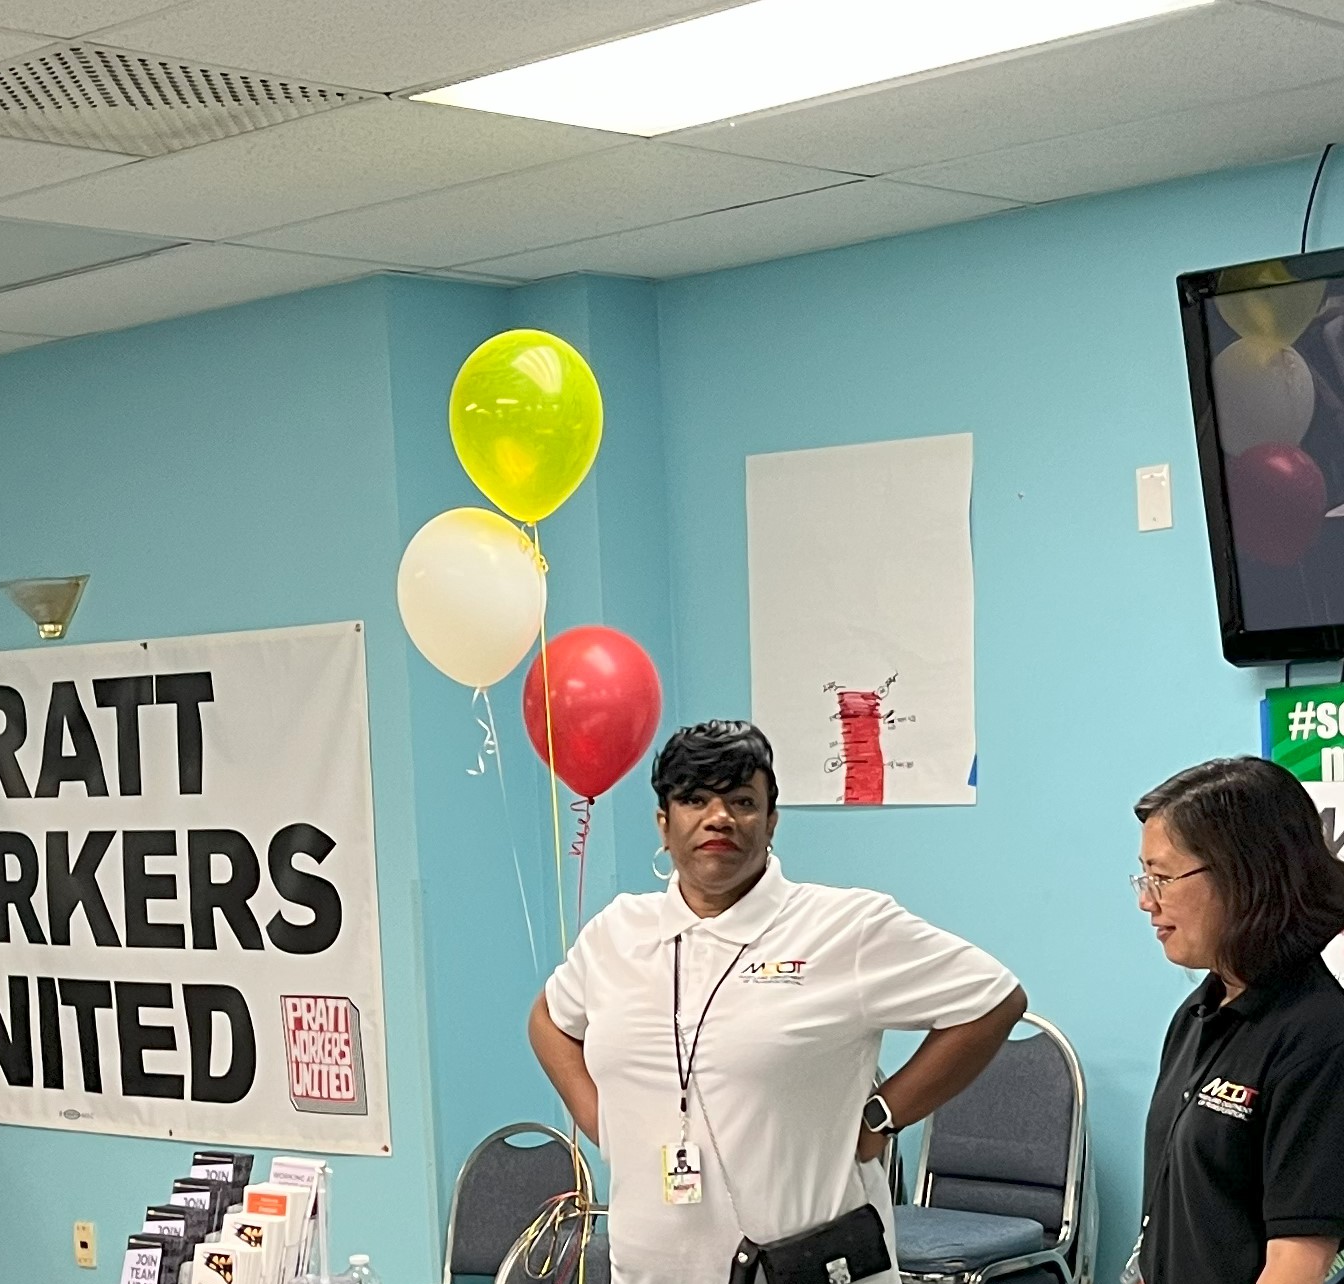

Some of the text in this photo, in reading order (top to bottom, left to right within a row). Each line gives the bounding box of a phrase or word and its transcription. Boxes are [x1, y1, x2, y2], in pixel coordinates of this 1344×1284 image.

[285, 998, 350, 1032] PRATT
[289, 1030, 351, 1065] WORKERS
[292, 1062, 354, 1099] UNITED
[131, 1267, 156, 1280] TEAM
[136, 1254, 158, 1266] JOIN
